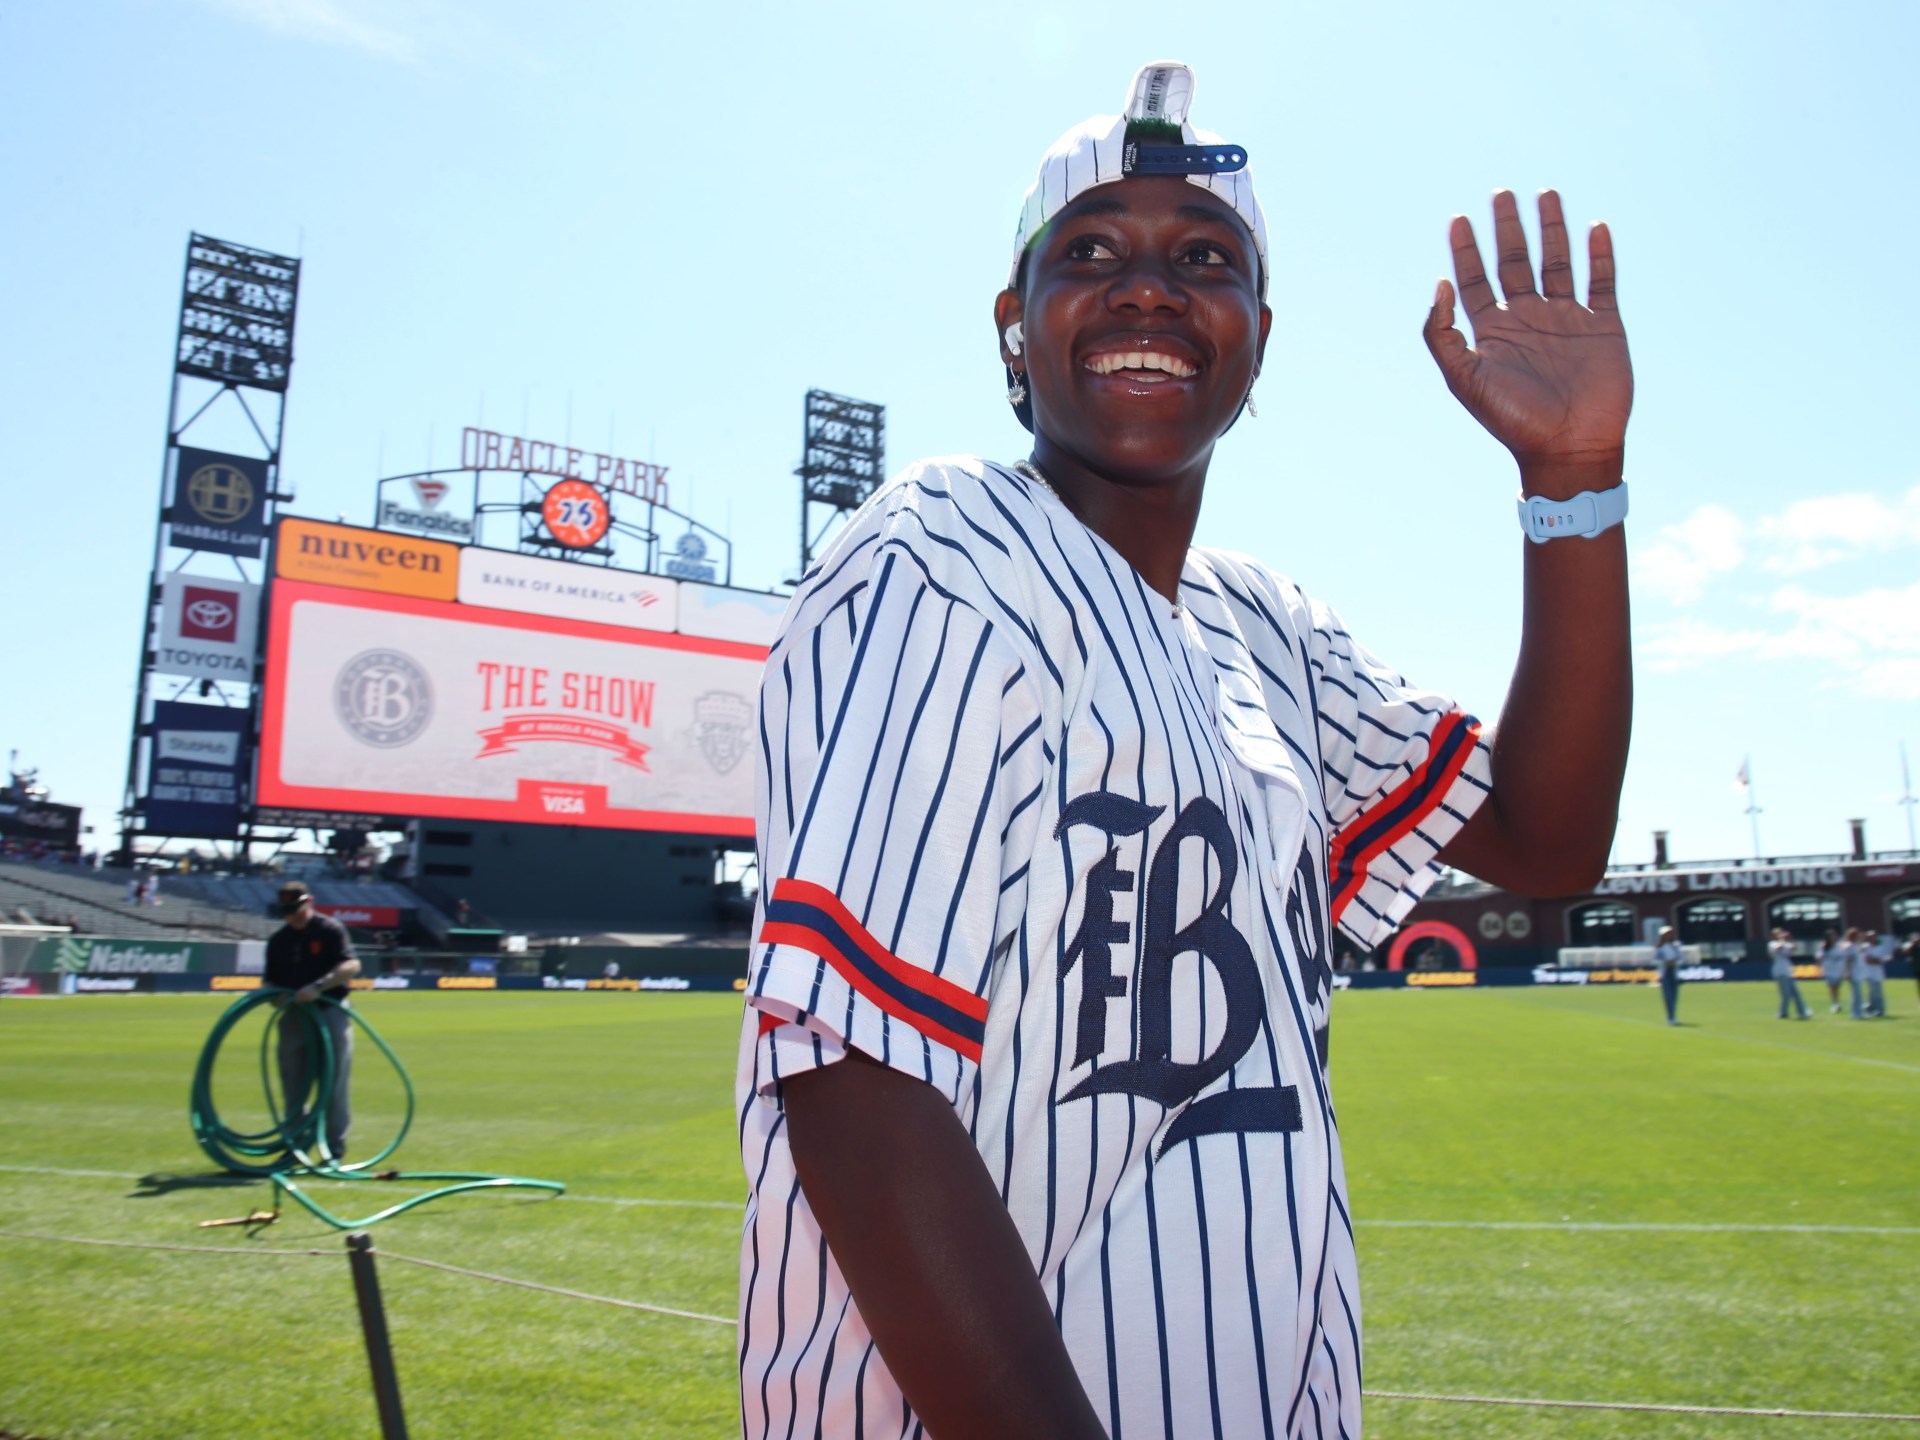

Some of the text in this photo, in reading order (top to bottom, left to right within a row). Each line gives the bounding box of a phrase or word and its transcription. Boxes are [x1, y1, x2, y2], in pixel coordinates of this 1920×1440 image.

[463, 427, 670, 509] ORACLE PARK
[384, 502, 472, 536] Fanatics
[556, 499, 597, 529] 76
[299, 533, 442, 574] nuveen
[482, 572, 626, 603] BANK OF AMERICA
[164, 648, 248, 671] TOYOTA
[477, 662, 549, 712] THE
[562, 671, 656, 729] SHOW
[542, 794, 587, 815] VISA
[1689, 866, 1846, 891] LANDING
[87, 944, 192, 974] National
